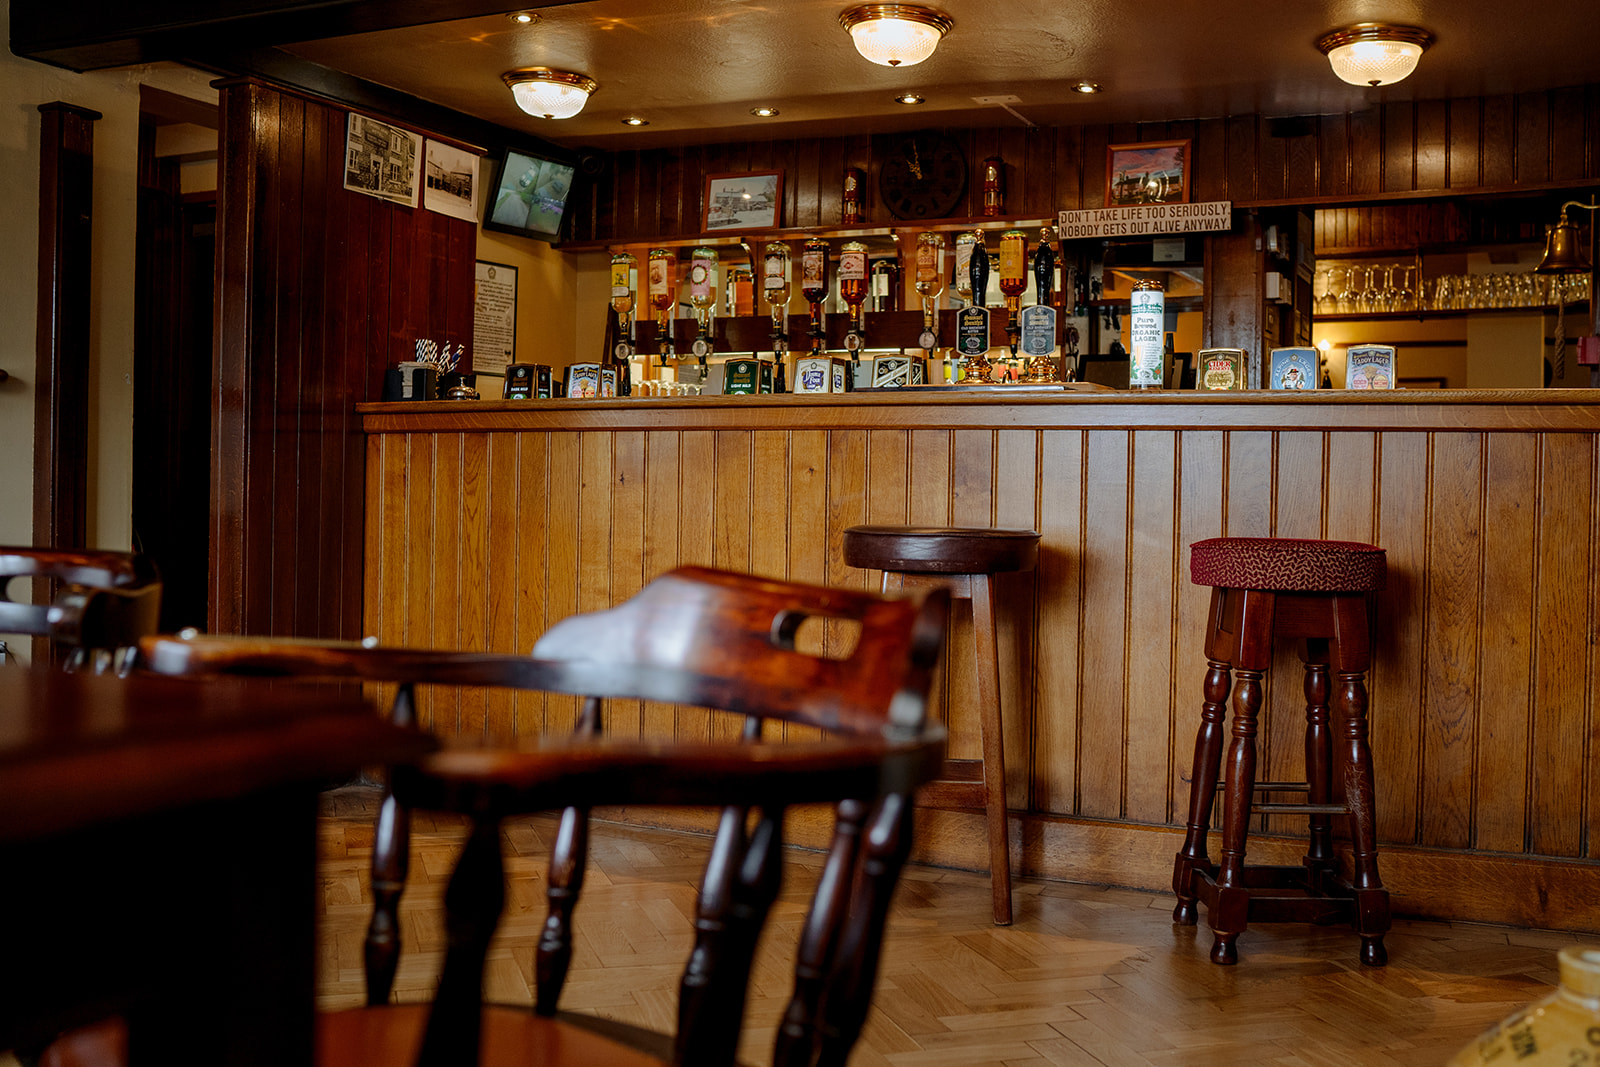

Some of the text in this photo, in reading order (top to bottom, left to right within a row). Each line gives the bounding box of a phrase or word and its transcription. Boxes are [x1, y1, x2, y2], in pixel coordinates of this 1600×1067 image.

[1060, 203, 1231, 224] DON'T TAKE LIFE TOO SERIOUSLY.
[1060, 217, 1231, 238] NOBODY GETS OUT ALIVE ANYWAY.
